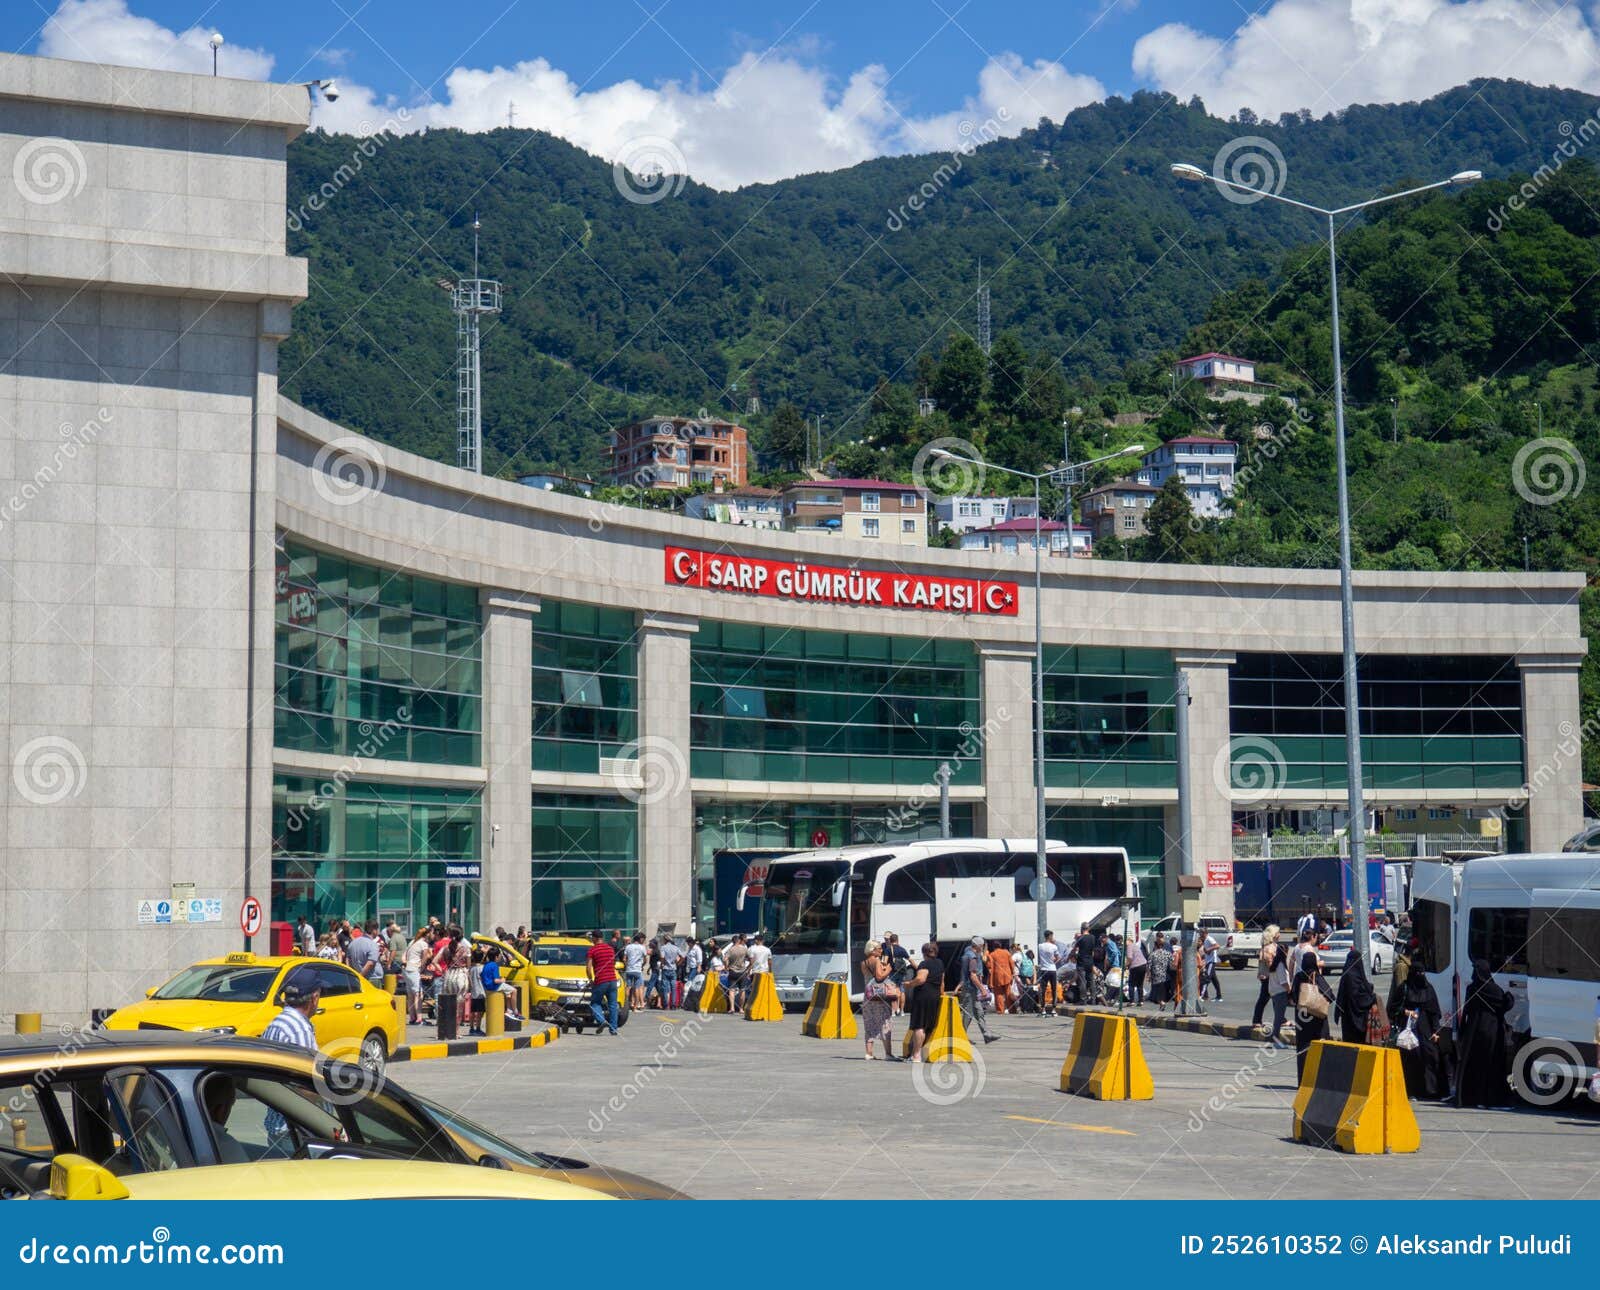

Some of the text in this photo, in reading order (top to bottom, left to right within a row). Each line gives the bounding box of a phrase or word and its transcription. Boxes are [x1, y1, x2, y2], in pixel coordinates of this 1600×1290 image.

[710, 560, 973, 608] SARP GÜMRÜK KAPISI
